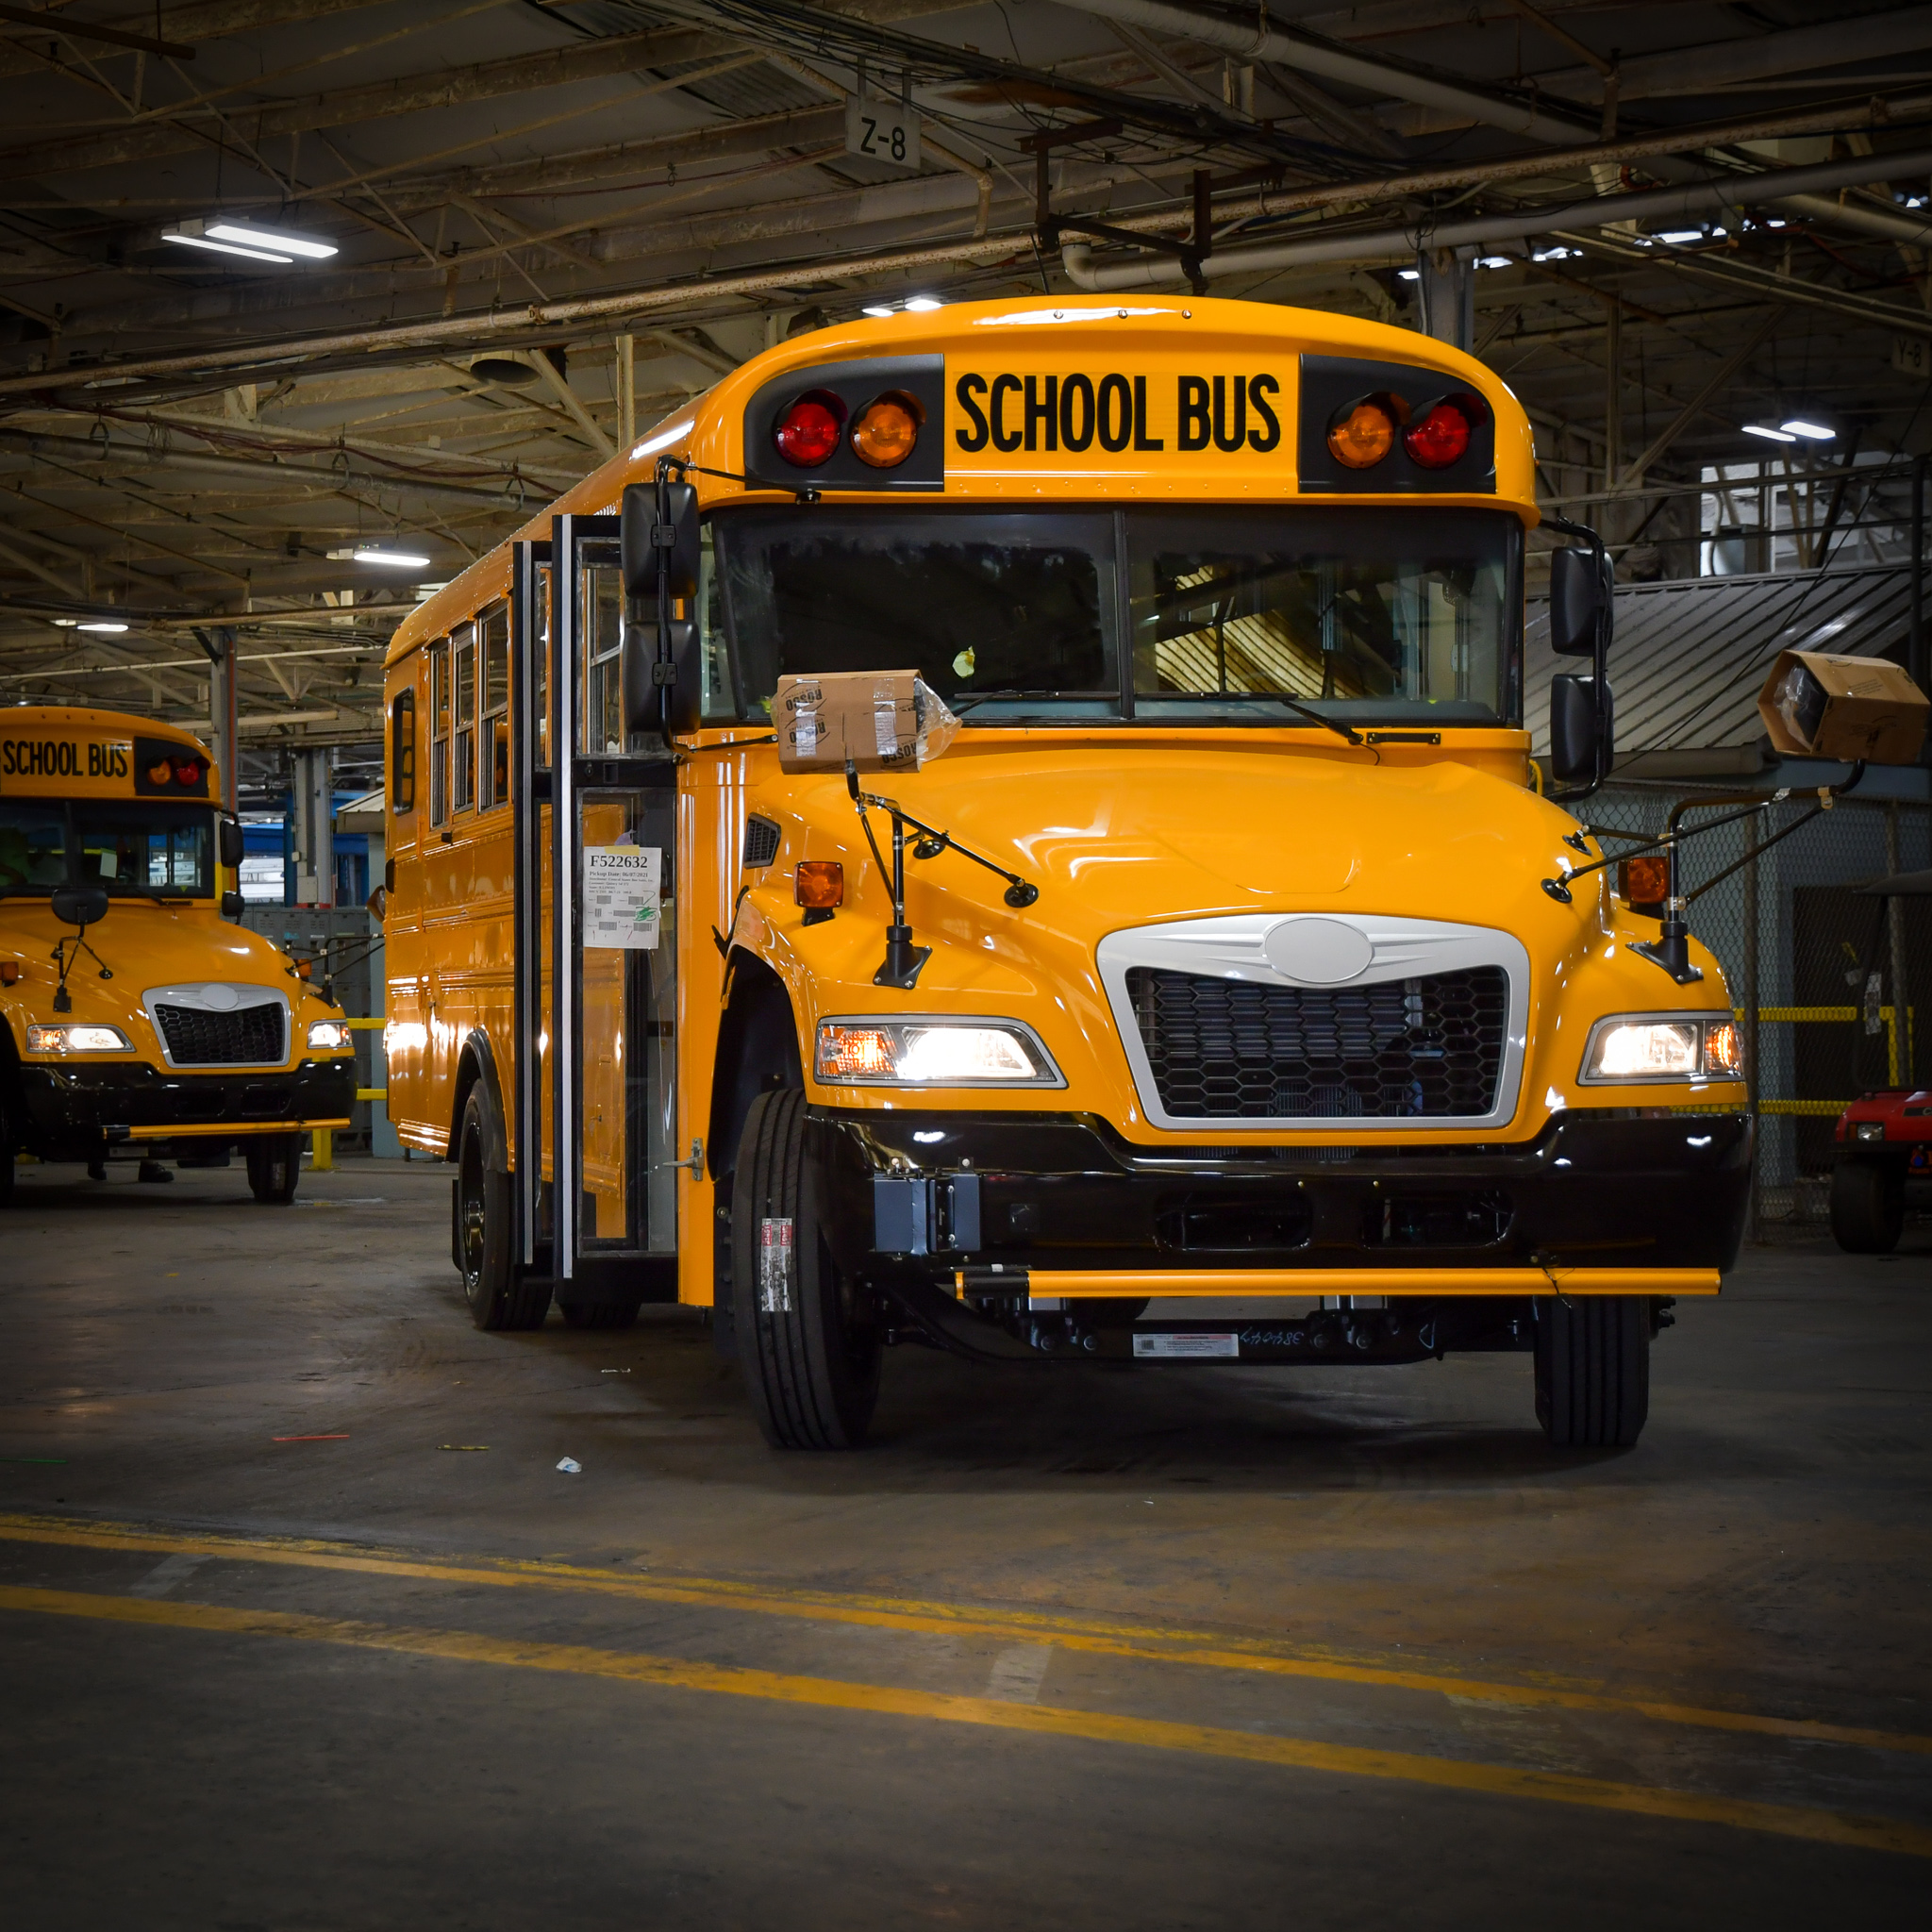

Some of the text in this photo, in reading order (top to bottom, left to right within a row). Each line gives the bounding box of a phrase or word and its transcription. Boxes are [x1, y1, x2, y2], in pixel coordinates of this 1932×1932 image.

[859, 116, 907, 161] Z-8
[956, 373, 1281, 453] SCHOOL BUS
[3, 740, 128, 778] SCHOOL BUS
[591, 855, 648, 868] F522632
